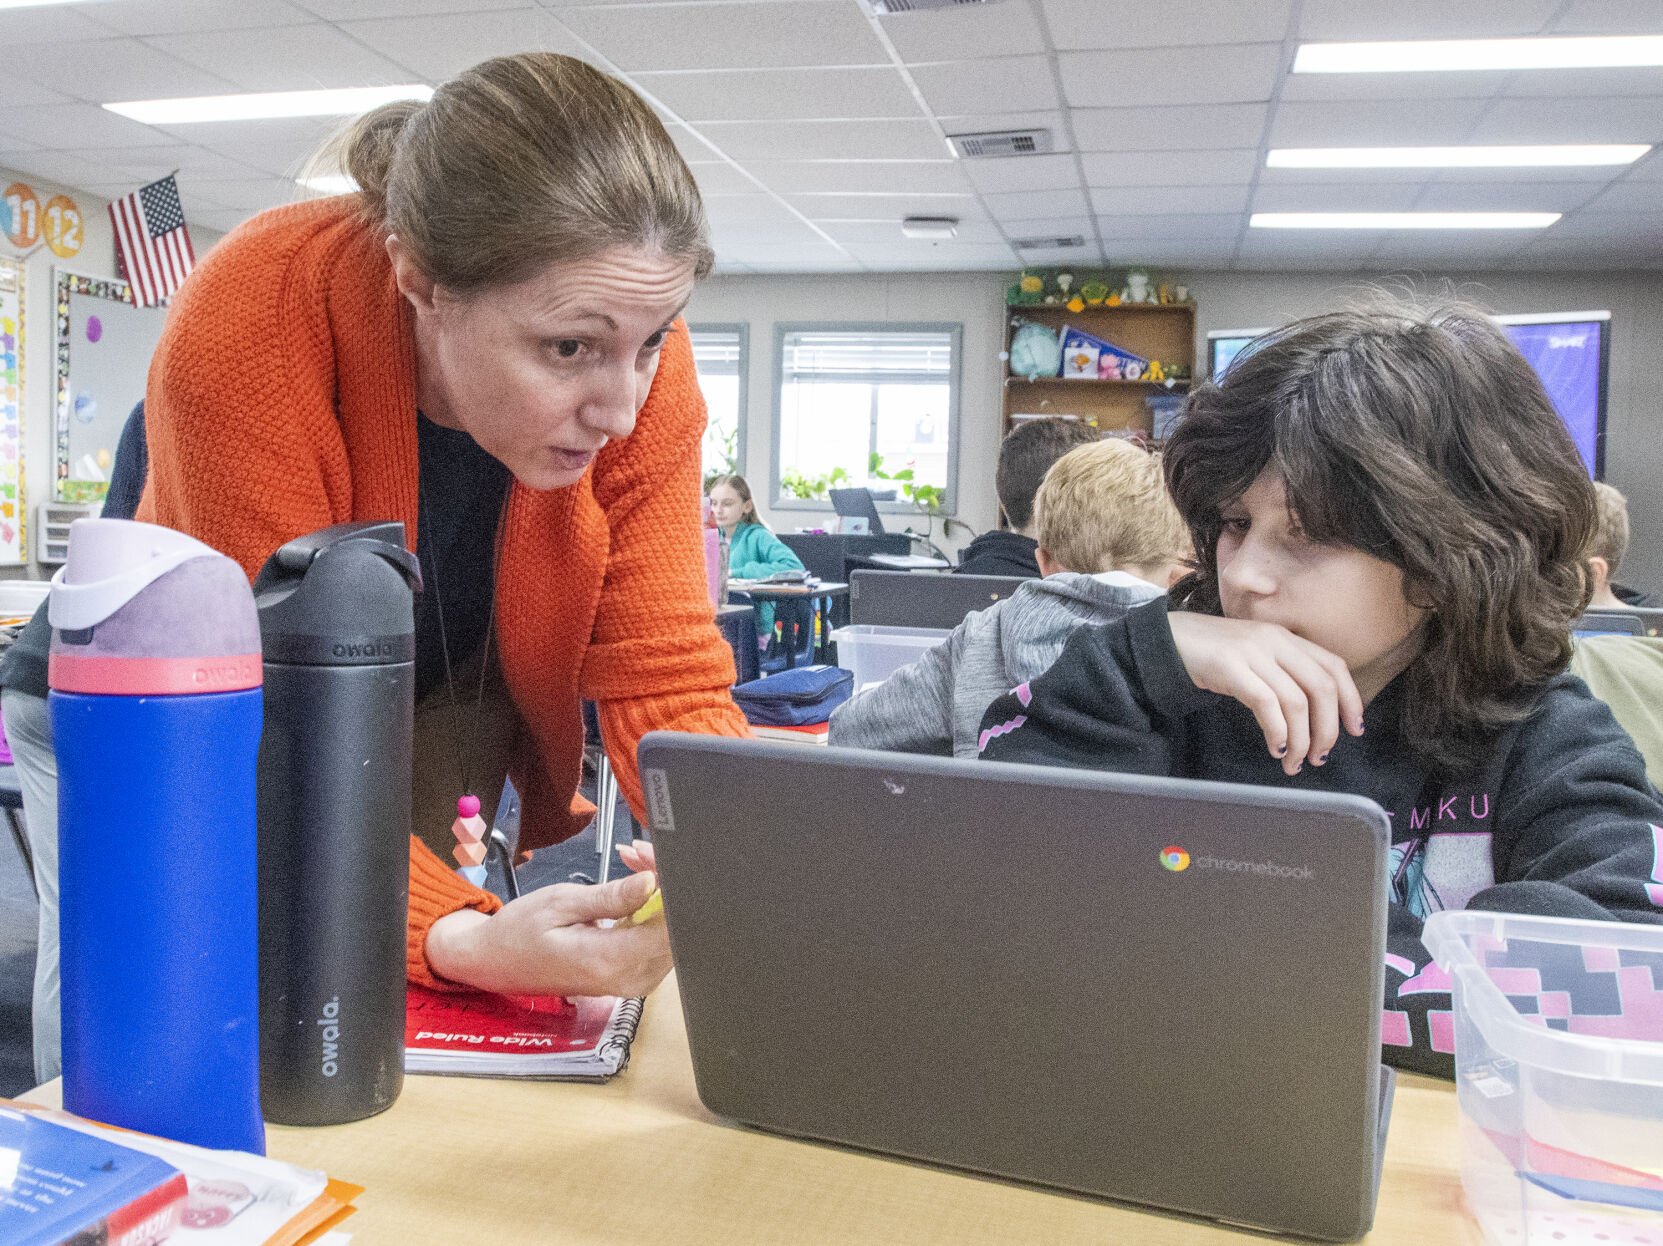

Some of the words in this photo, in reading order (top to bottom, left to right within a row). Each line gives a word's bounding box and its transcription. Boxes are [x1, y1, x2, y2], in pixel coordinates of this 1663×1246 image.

[6, 194, 35, 239] 11
[48, 206, 79, 249] 12
[332, 641, 393, 658] owala
[415, 1031, 486, 1044] Ruled
[489, 1035, 553, 1047] Wide
